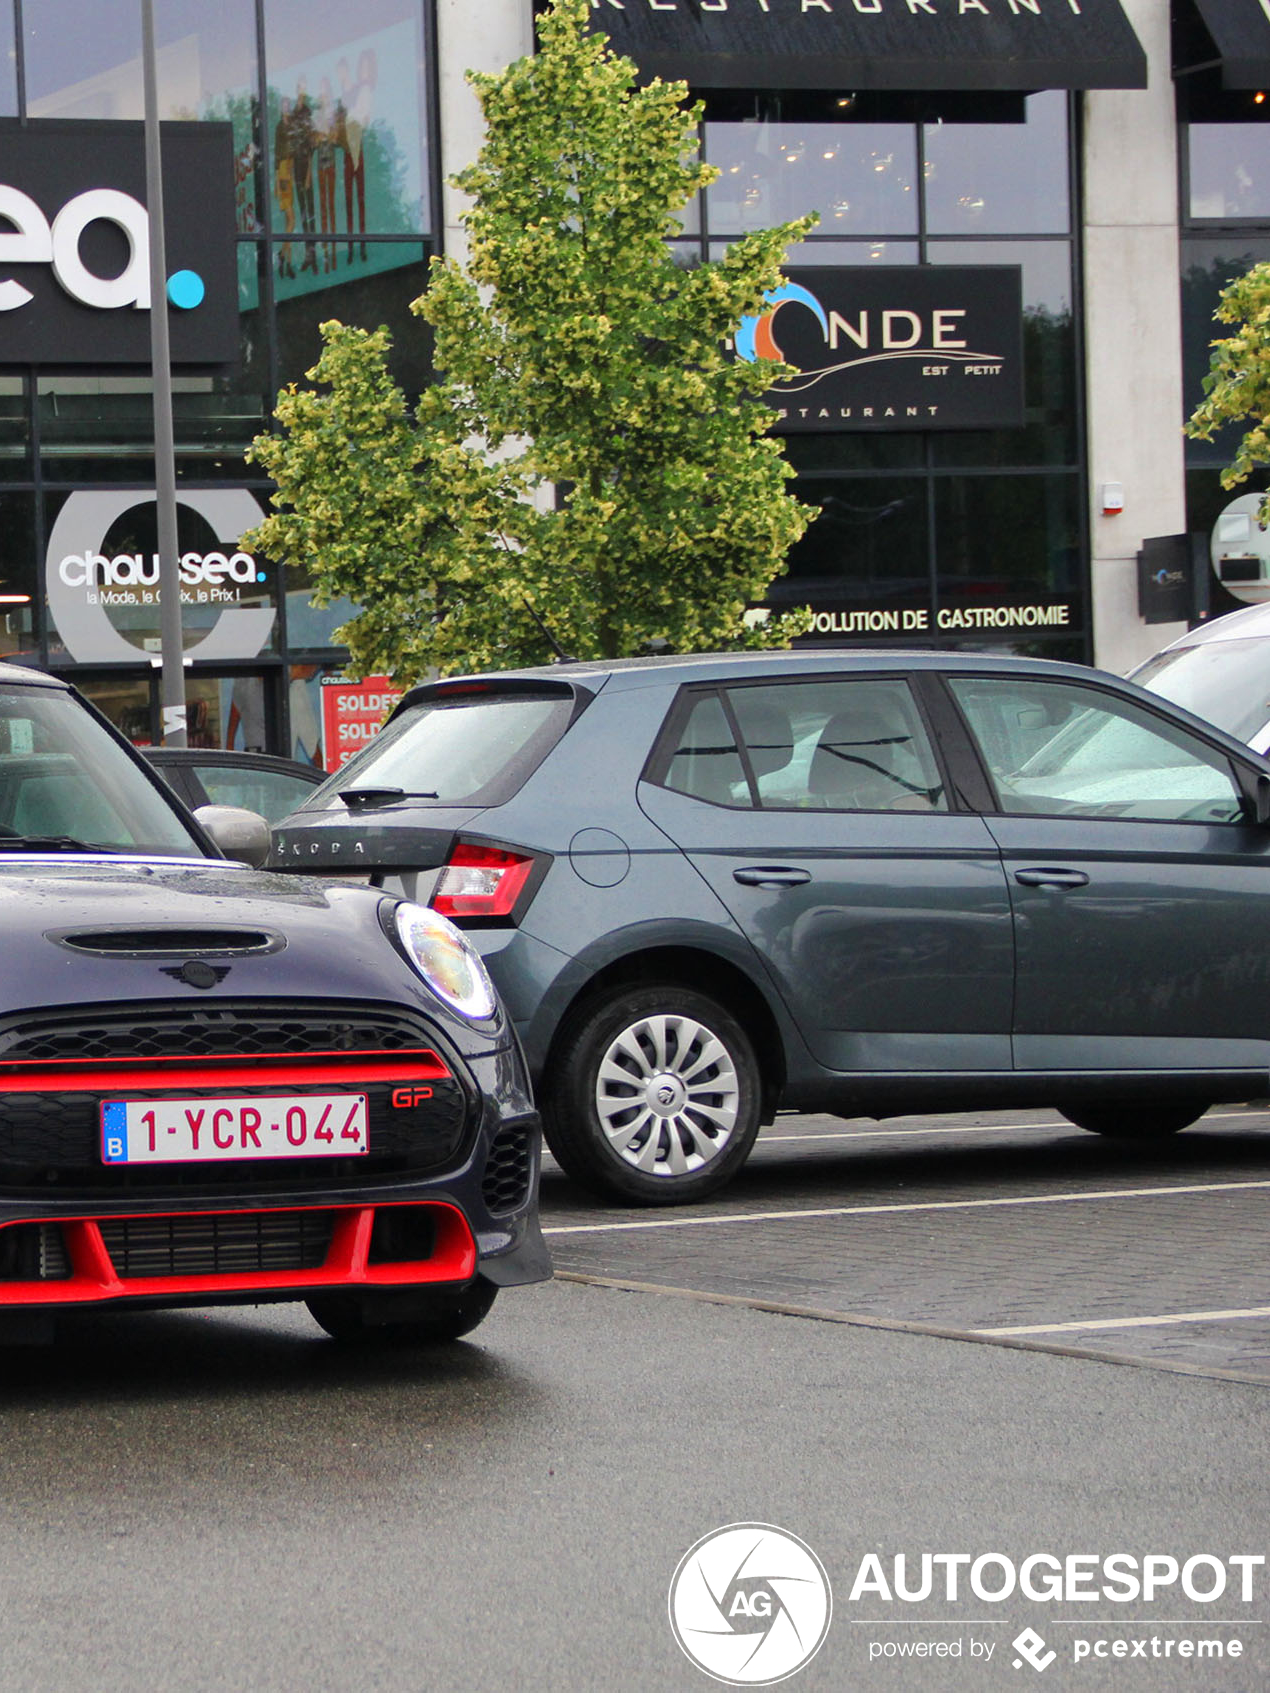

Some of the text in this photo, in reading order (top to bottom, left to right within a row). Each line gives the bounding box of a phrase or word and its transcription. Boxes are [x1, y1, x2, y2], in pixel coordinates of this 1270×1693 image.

[922, 365, 1003, 376] EST PETIT
[776, 406, 938, 419] STAURANT
[87, 591, 97, 604] la
[142, 590, 153, 603] le
[197, 589, 207, 602] le
[210, 588, 233, 601] Prix
[903, 609, 928, 630] DE
[937, 604, 1070, 629] GASTRONOMIE
[392, 1087, 433, 1108] GP
[108, 1103, 361, 1157] B 1-YCR-044
